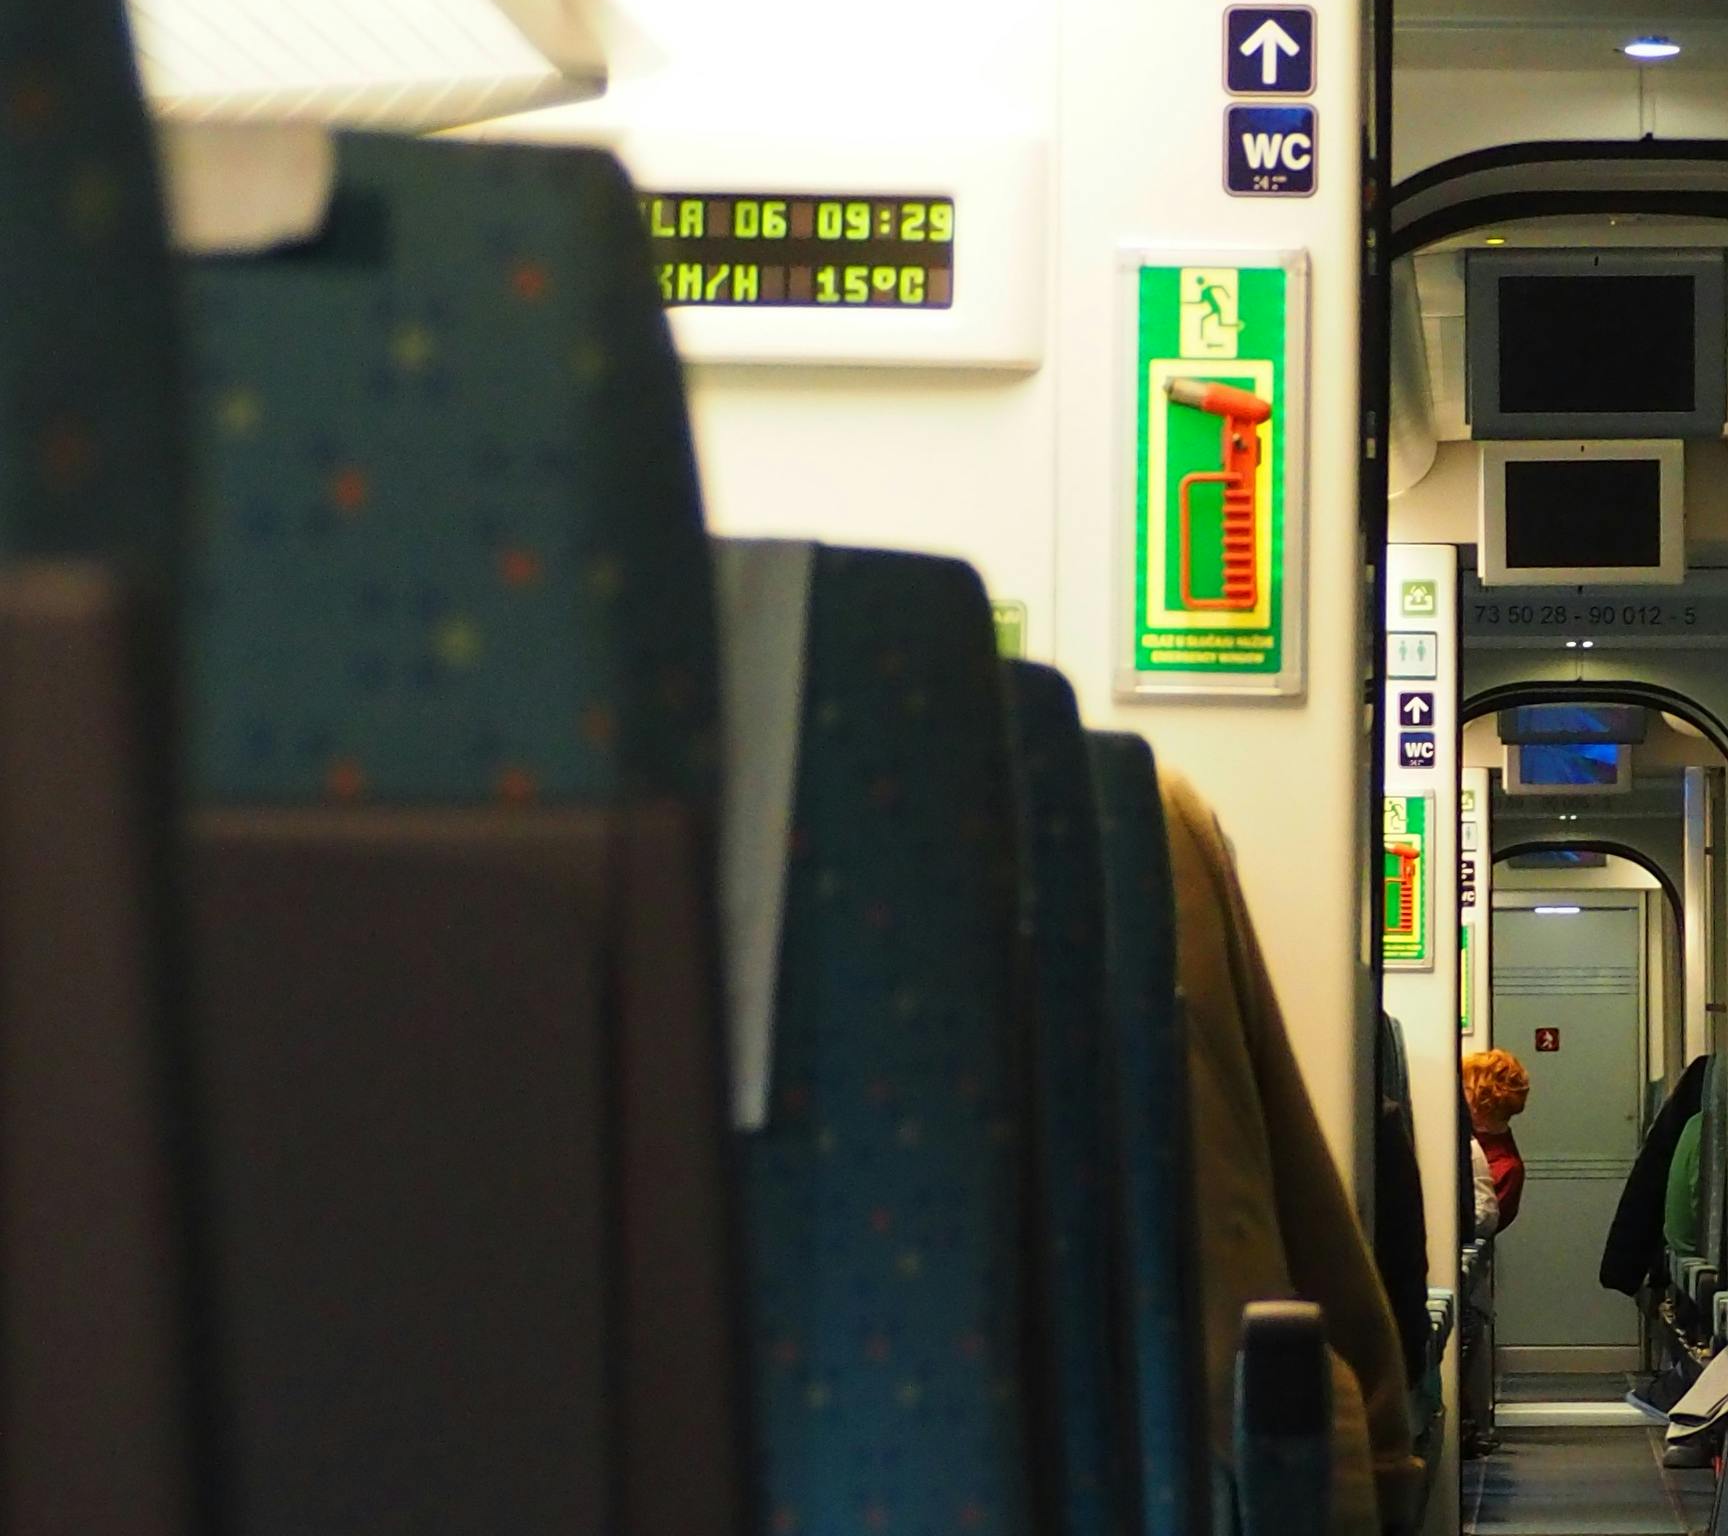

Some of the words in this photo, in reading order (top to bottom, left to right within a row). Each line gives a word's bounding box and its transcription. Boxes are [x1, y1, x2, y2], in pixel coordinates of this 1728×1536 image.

[1242, 133, 1311, 171] WC
[642, 199, 704, 238] LA
[734, 201, 787, 239] 06
[817, 202, 952, 243] 09:29
[1474, 605, 1500, 625] 73
[1508, 605, 1535, 625] 50
[1540, 605, 1568, 625] 28
[1588, 605, 1616, 625] 90
[1621, 605, 1663, 626] 012
[1684, 606, 1697, 626] 5
[1404, 741, 1434, 758] WC
